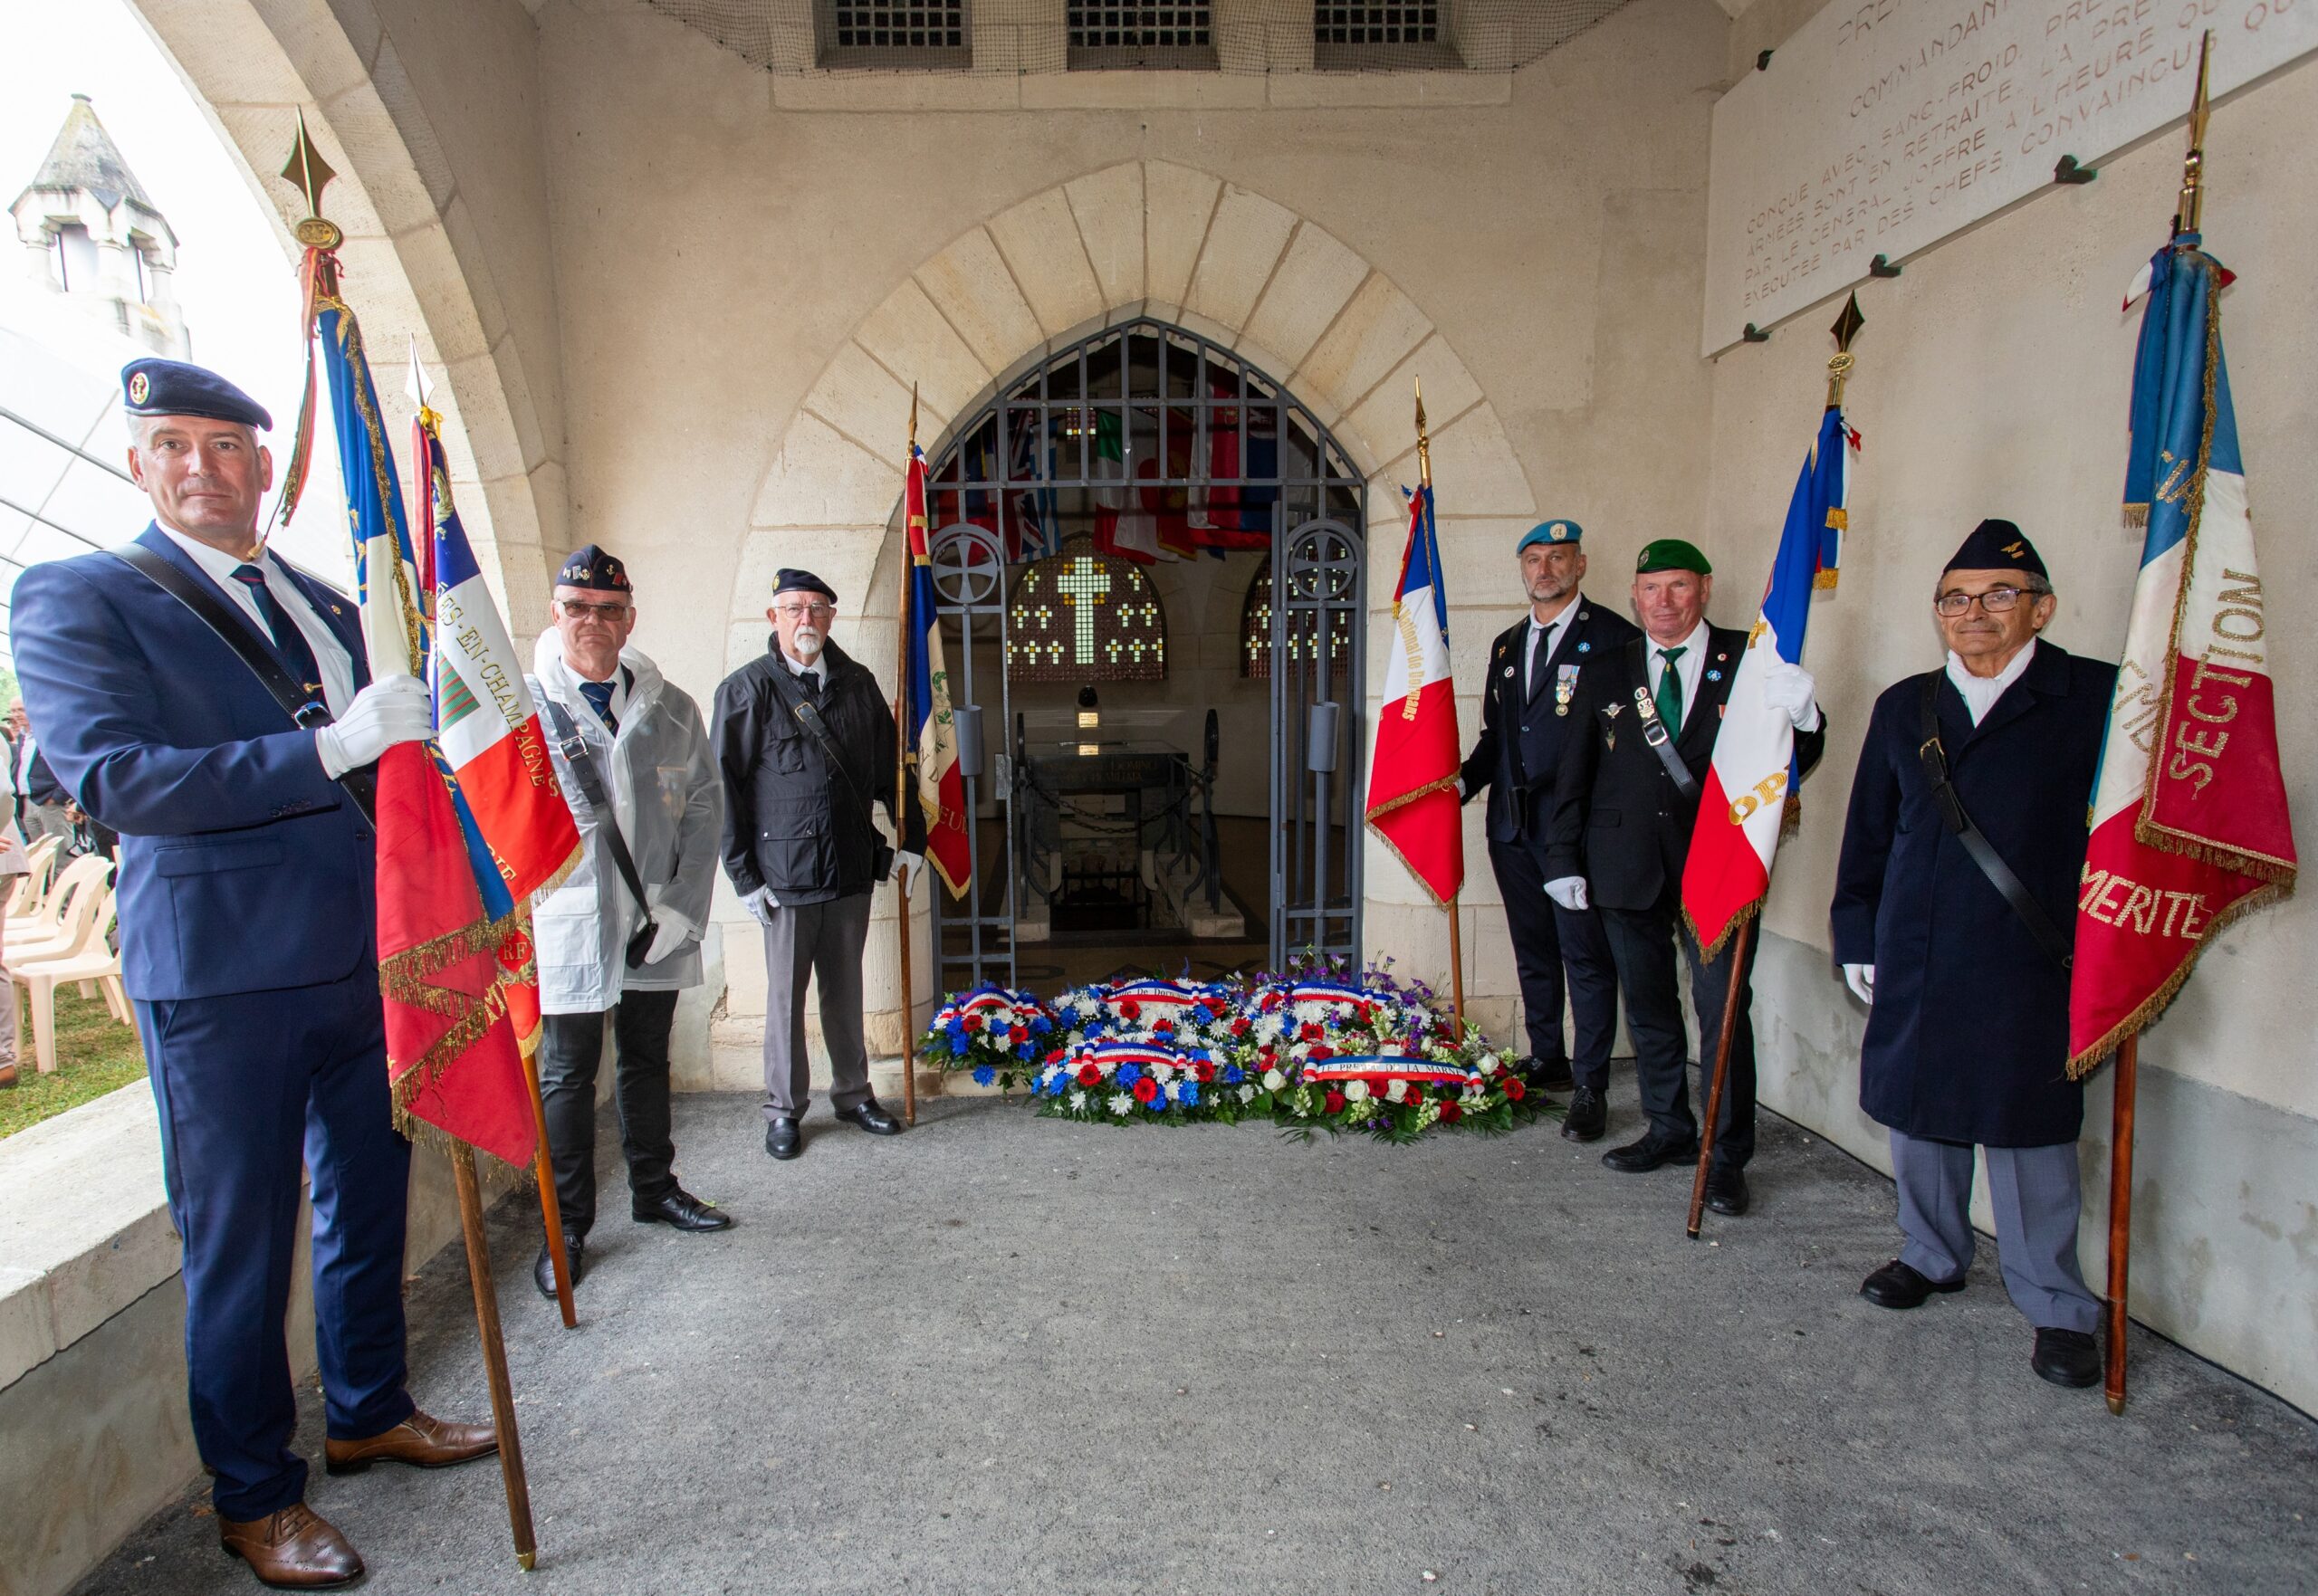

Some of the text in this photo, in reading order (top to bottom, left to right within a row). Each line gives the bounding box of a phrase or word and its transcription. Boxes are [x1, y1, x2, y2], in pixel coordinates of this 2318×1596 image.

[1837, 0, 1900, 54] PRE
[2045, 0, 2102, 39] PRE
[1814, 177, 1858, 218] SONT
[1869, 158, 1891, 185] EN
[2041, 43, 2072, 78] LA
[2092, 0, 2159, 42] PRE
[1832, 228, 1865, 257] PAR
[1877, 200, 1914, 235] DES
[2245, 0, 2294, 32] QU
[1745, 257, 1772, 282] PAR
[1782, 240, 1799, 263] LE
[1903, 128, 1986, 191] JOFFRE
[2178, 0, 2218, 30] QU
[1398, 607, 1423, 656] National
[1407, 653, 1424, 670] de
[2169, 568, 2265, 793] SECTION
[503, 941, 528, 960] RF
[1426, 1065, 1462, 1075] MARNE
